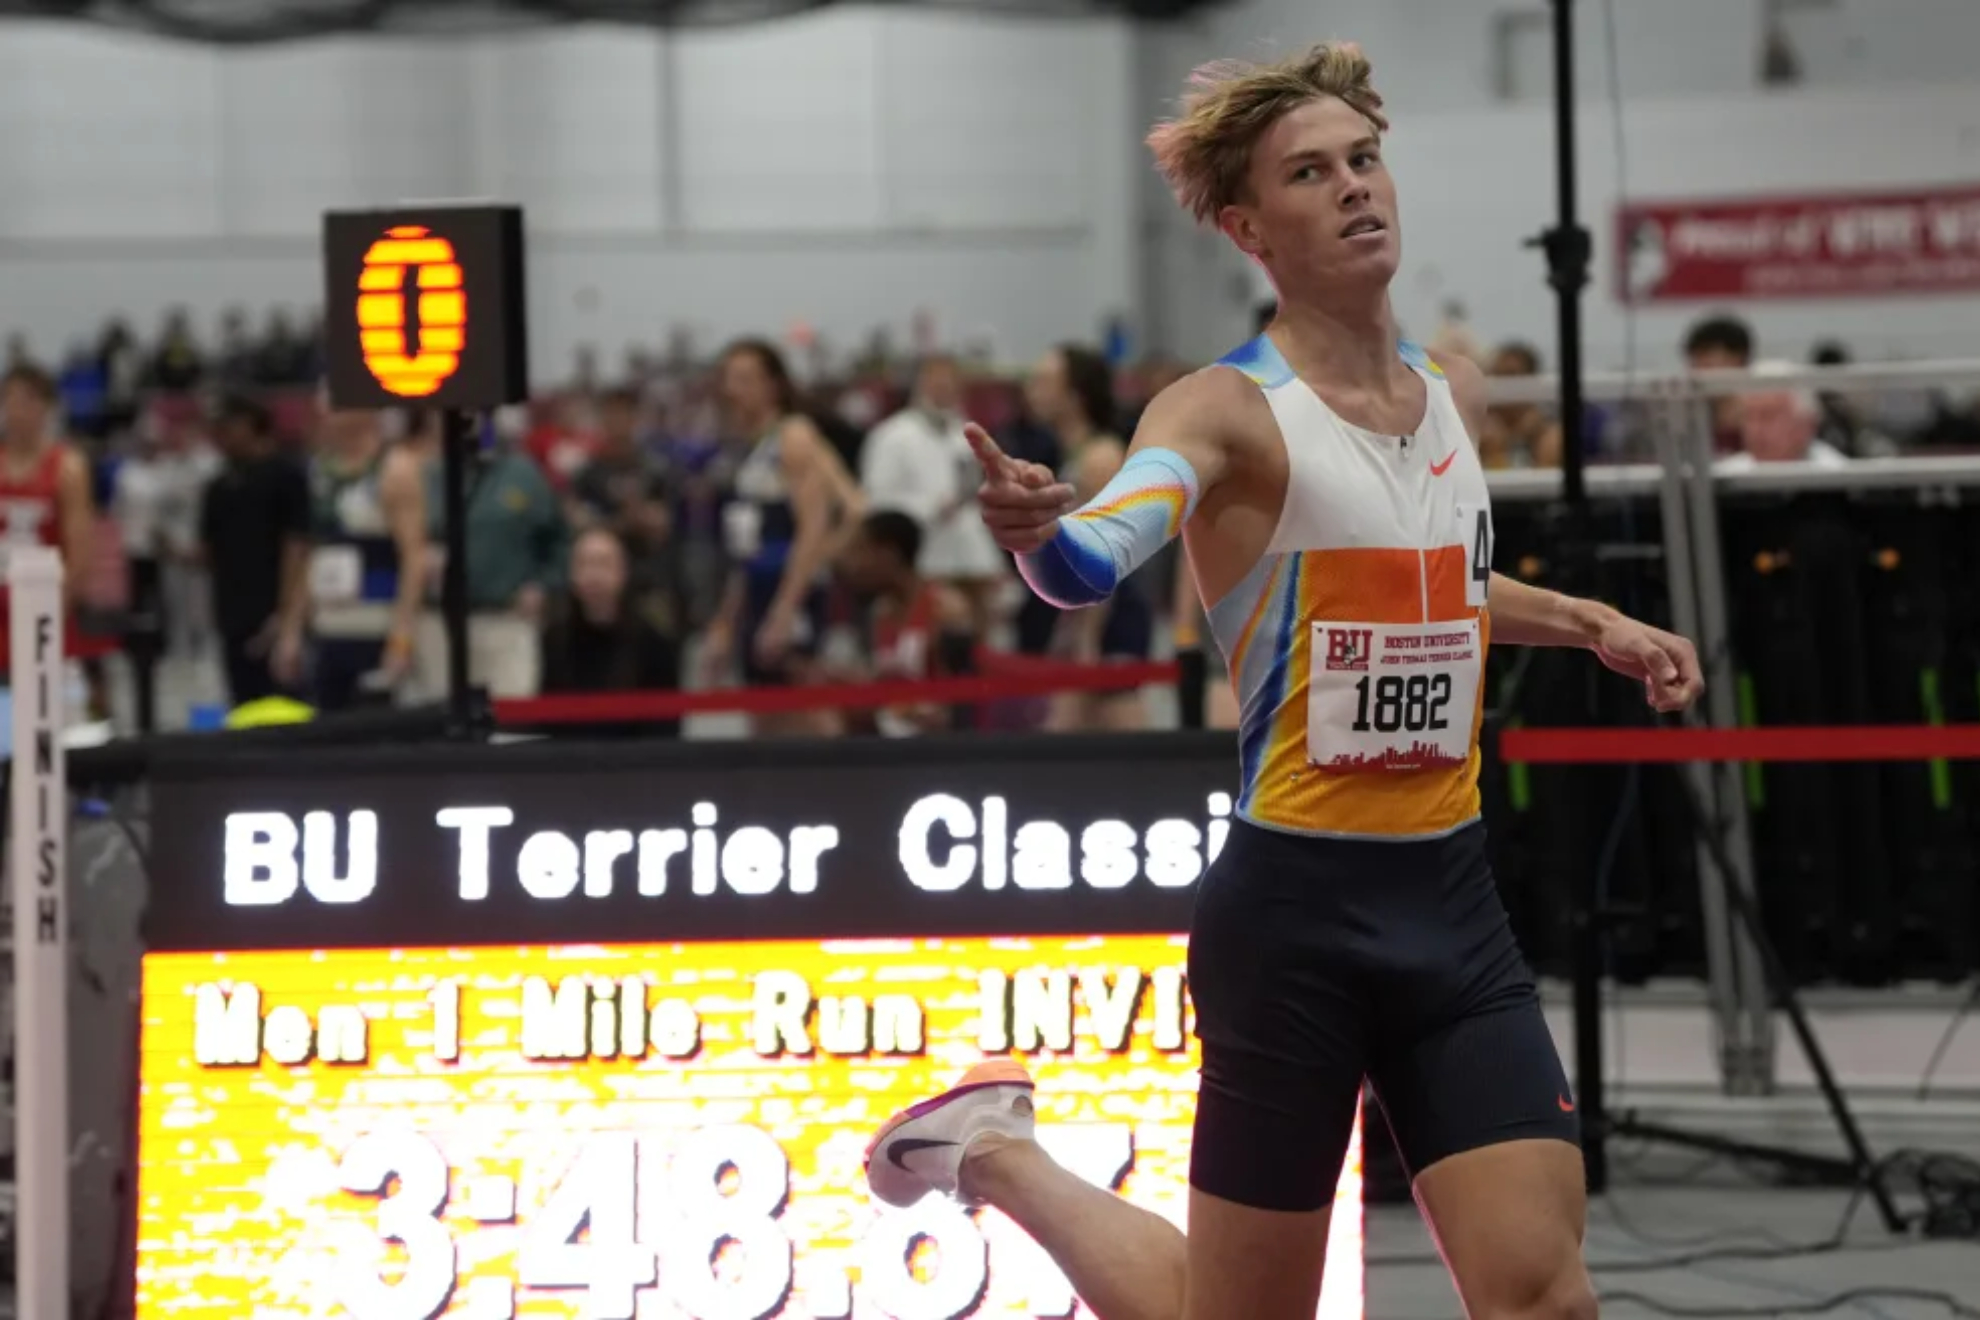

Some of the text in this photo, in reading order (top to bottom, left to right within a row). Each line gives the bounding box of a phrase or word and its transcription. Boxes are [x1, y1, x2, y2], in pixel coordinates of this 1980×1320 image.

[357, 226, 467, 397] 0
[1473, 510, 1490, 599] 4
[1327, 629, 1373, 663] BU
[1424, 631, 1469, 647] UNIVERSITY
[1352, 673, 1452, 732] 1882
[35, 614, 57, 944] FINISH
[224, 809, 378, 904] BU
[435, 801, 839, 900] Terrier
[195, 981, 368, 1066] Men
[427, 976, 459, 1064] 1
[522, 974, 700, 1063] Mile
[753, 970, 925, 1056] Run
